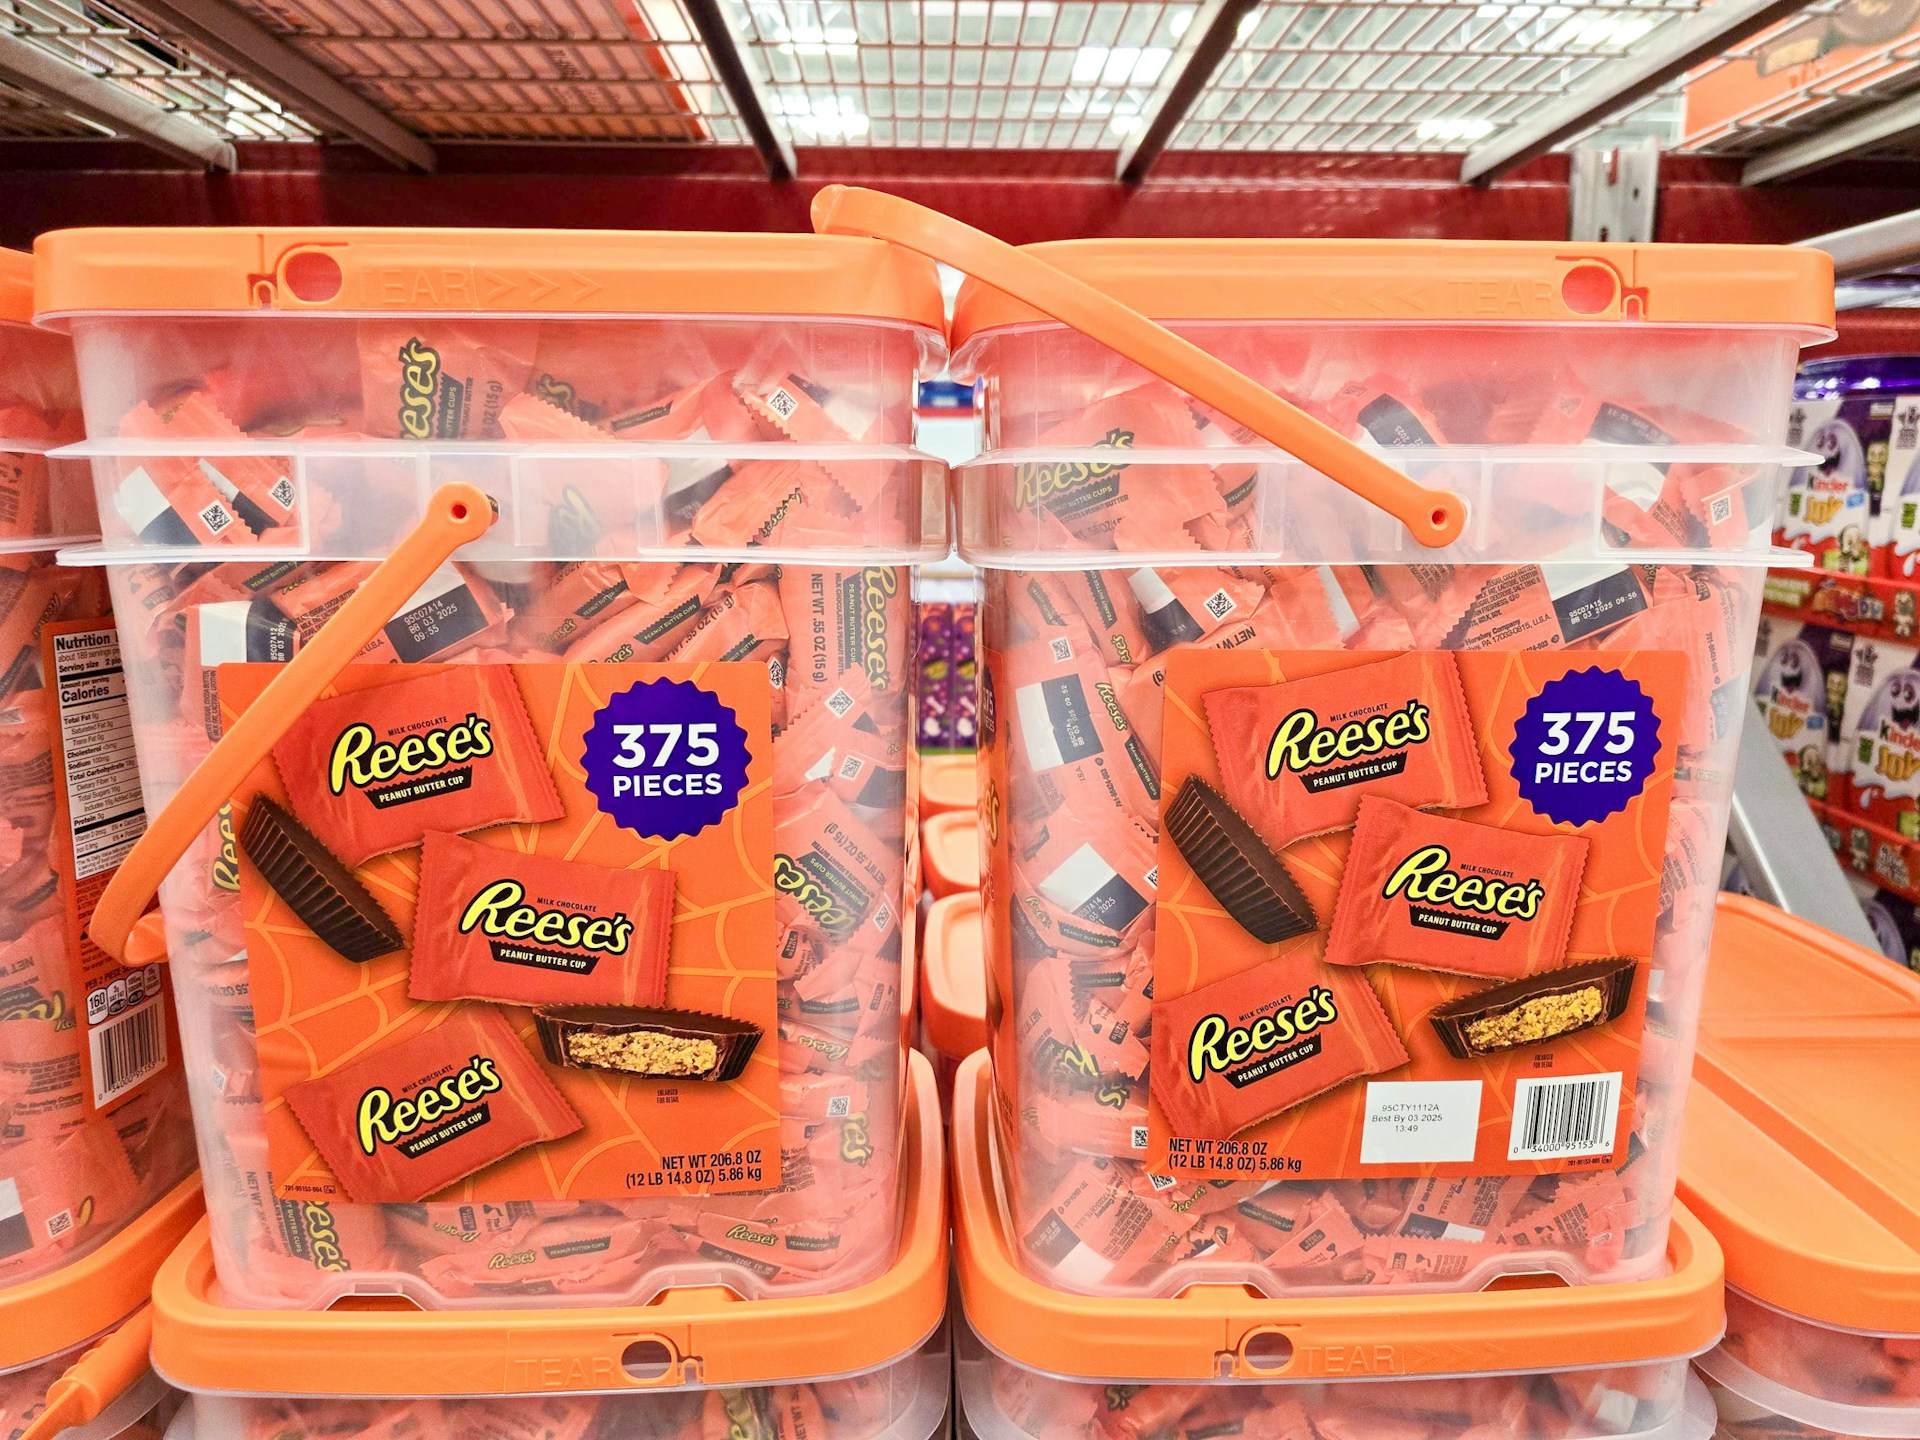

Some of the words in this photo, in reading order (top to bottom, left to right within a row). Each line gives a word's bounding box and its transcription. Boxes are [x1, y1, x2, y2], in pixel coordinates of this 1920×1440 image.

[355, 269, 468, 305] TEAR
[1447, 279, 1556, 315] TEAR
[448, 387, 457, 408] CUPS
[1068, 494, 1092, 507] BUTTER
[1092, 485, 1113, 498] CUPS
[250, 574, 271, 588] PEANUT
[811, 573, 824, 595] NET
[812, 597, 825, 616] WT
[848, 583, 856, 615] PEANUT
[403, 600, 444, 626] 95C07A14
[408, 623, 421, 635] BB
[422, 615, 435, 627] 03
[436, 603, 458, 620] 2025
[643, 624, 665, 641] PEANUT
[664, 612, 684, 628] BUTTER
[683, 603, 697, 617] CUPS
[697, 615, 712, 631] OZ
[723, 593, 736, 610] g)
[1570, 616, 1581, 625] BB
[1582, 612, 1593, 623] 03
[1595, 601, 1613, 615] 2025
[413, 624, 440, 643] 09:55
[813, 618, 826, 634] .55
[849, 616, 857, 647] BUTTER
[1234, 626, 1257, 646] NET
[1491, 619, 1521, 635] Company
[55, 633, 110, 651] Nutrition
[277, 640, 285, 650] 03
[739, 638, 758, 654] BUTTER
[813, 636, 826, 652] OZ
[1491, 638, 1502, 648] PA
[58, 653, 76, 663] about
[58, 663, 85, 673] Serving
[86, 660, 99, 669] size
[812, 653, 828, 669] (15
[812, 672, 828, 683] g)
[61, 684, 110, 703] Calories
[1094, 682, 1128, 731] Reese's
[1329, 712, 1348, 723] MILK
[1349, 703, 1389, 718] CHOCOLATE
[64, 716, 80, 725] Total
[81, 713, 92, 722] Fat
[387, 726, 406, 737] MILK
[407, 716, 448, 732] CHOCOLATE
[1266, 699, 1430, 780] Reese's
[1537, 710, 1636, 756] 375
[67, 745, 102, 759] Cholesterol
[330, 713, 493, 796] Reese's
[612, 723, 720, 768] 375
[68, 760, 92, 771] Sodium
[69, 772, 86, 782] Total
[86, 762, 126, 777] Carbohydrate
[1313, 772, 1346, 787] PEANUT
[1348, 765, 1380, 780] BUTTER
[1381, 760, 1398, 772] CUP
[1534, 760, 1633, 784] PIECES
[379, 788, 412, 803] PEANUT
[414, 779, 447, 795] BUTTER
[447, 775, 465, 787] CUP
[612, 772, 723, 798] PIECES
[73, 815, 97, 826] Protein
[809, 857, 827, 875] CUPS
[1460, 863, 1476, 873] MILK
[1477, 866, 1514, 879] CHOCOLATE
[825, 867, 847, 887] BUTTER
[1384, 845, 1544, 921] Reese's
[536, 896, 555, 906] MILK
[556, 900, 598, 913] CHOCOLATE
[1101, 897, 1116, 914] 2025
[459, 879, 635, 956] Reese's
[1418, 913, 1451, 927] PEANUT
[1451, 919, 1480, 932] BUTTER
[1481, 924, 1498, 935] CUP
[499, 948, 534, 961] PEANUT
[535, 953, 568, 967] BUTTER
[569, 958, 587, 970] CUP
[89, 992, 106, 1010] 160
[1238, 1010, 1255, 1023] MILK
[1255, 994, 1293, 1015] CHOCOLATE
[1188, 985, 1338, 1084] Reese's
[1237, 1065, 1268, 1083] PEANUT
[1268, 1052, 1299, 1070] BUTTER
[1299, 1043, 1315, 1057] CUP
[402, 1082, 418, 1094] MILK
[418, 1063, 454, 1086] CHOCOLATE
[357, 1055, 502, 1156] Reese's
[1381, 1103, 1440, 1113] 95CTY1112A
[1371, 1113, 1392, 1123] Best
[1393, 1113, 1405, 1125] By
[1407, 1113, 1419, 1122] 03
[1421, 1113, 1443, 1122] 2025
[1394, 1124, 1419, 1133] 13:49
[409, 1133, 439, 1153] PEANUT
[439, 1119, 468, 1139] BUTTER
[467, 1112, 483, 1126] CUP
[1169, 1138, 1192, 1152] NET
[1194, 1139, 1214, 1153] WT
[1216, 1141, 1249, 1156] 206.8
[1252, 1142, 1268, 1155] OZ
[1513, 1146, 1519, 1154] 0
[1530, 1144, 1561, 1153] 34000
[1565, 1141, 1594, 1151] 95153
[662, 1156, 685, 1170] NET
[688, 1155, 707, 1168] WT
[710, 1151, 743, 1168] 206.8
[745, 1150, 762, 1164] OZ
[1168, 1154, 1188, 1169] (12
[1190, 1155, 1205, 1169] LB
[1209, 1157, 1234, 1170] 14.8
[1237, 1158, 1257, 1173] OZ)
[1259, 1158, 1284, 1171] 5.86
[1287, 1158, 1302, 1173] kg
[246, 1171, 259, 1191] NET
[625, 1173, 645, 1190] (12
[647, 1171, 664, 1186] LB
[667, 1170, 693, 1185] 14.8
[695, 1168, 715, 1185] OZ)
[718, 1167, 744, 1182] 5.86
[746, 1165, 762, 1182] kg
[287, 1209, 298, 1234] BUTTER
[293, 1235, 302, 1253] CUPS
[726, 1223, 779, 1247] Reese's
[789, 1239, 810, 1249] PEANUT
[488, 1249, 537, 1270] Reese's
[1299, 1345, 1396, 1374] TEAR
[514, 1356, 618, 1387] TEAR
